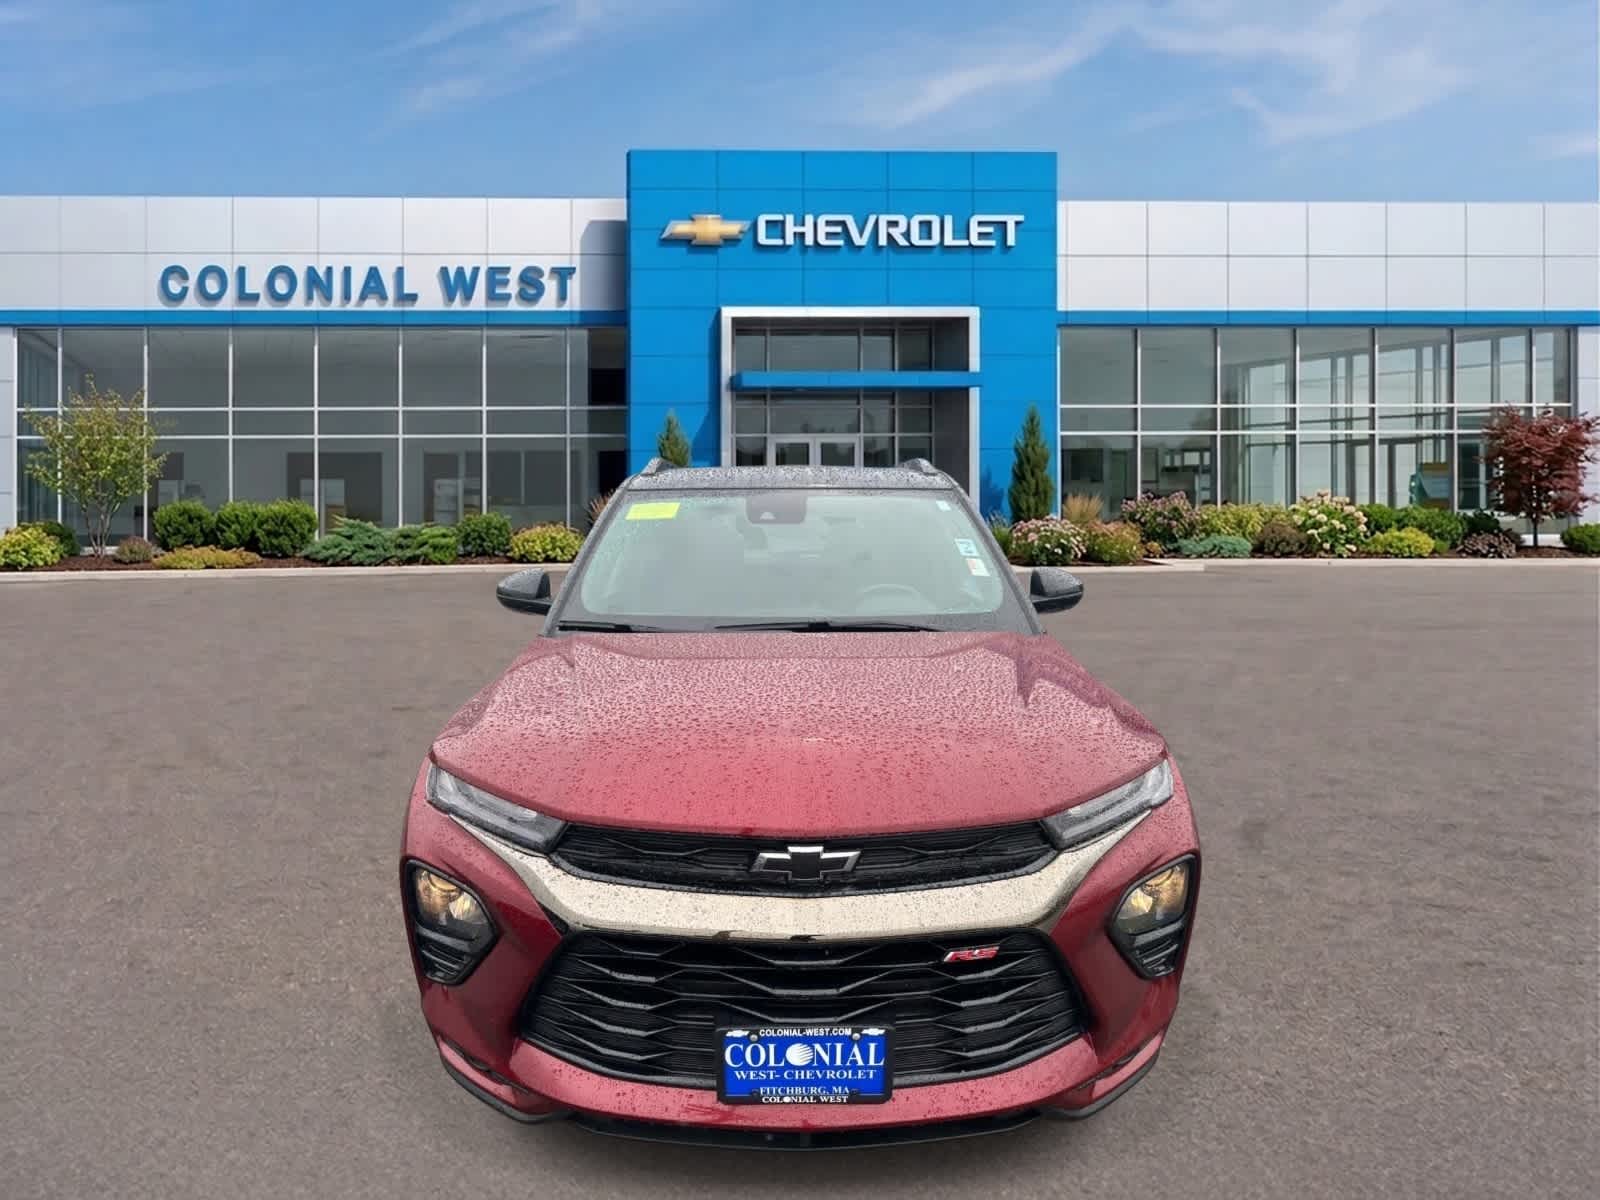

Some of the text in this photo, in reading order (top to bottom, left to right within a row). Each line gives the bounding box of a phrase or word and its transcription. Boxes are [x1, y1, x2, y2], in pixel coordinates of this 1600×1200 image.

[756, 213, 1024, 247] CHEVROLET
[159, 265, 576, 305] COLONIAL WEST
[943, 946, 1000, 962] RS
[759, 1028, 852, 1037] COLONIAL-WEST.COM
[783, 1069, 877, 1080] CHEVROLET
[832, 1086, 850, 1095] MA
[819, 1095, 849, 1104] WEST
